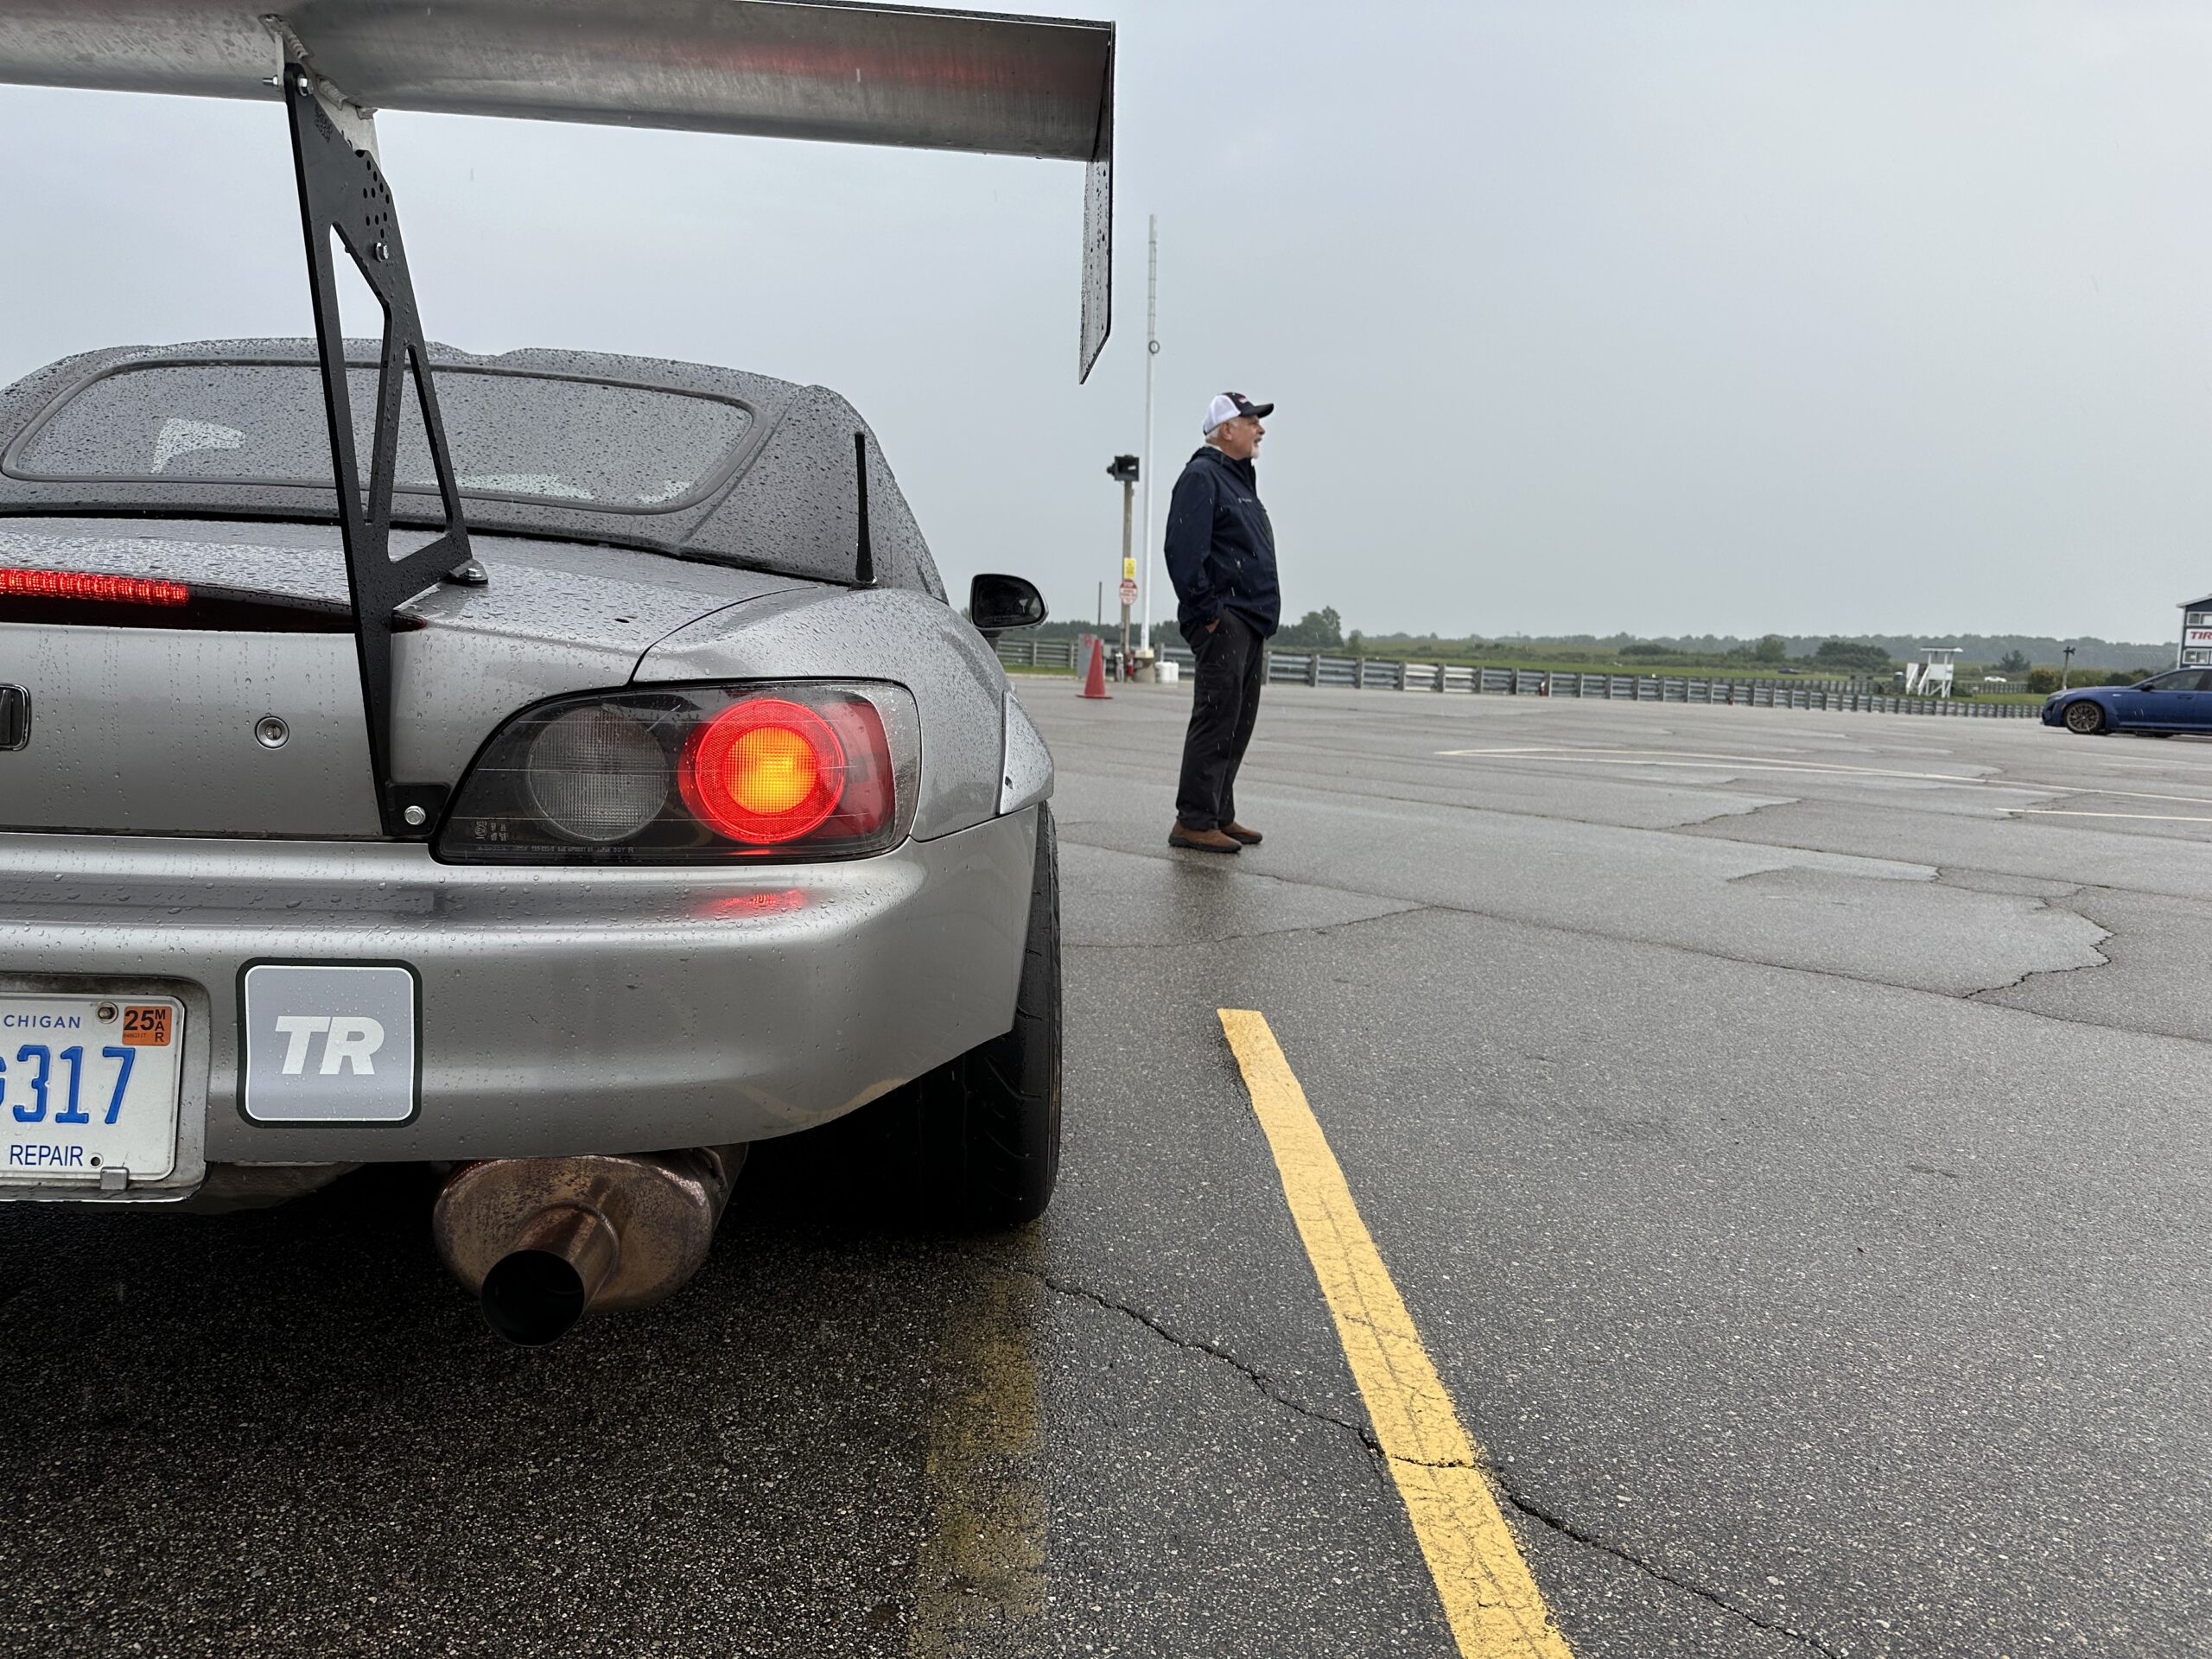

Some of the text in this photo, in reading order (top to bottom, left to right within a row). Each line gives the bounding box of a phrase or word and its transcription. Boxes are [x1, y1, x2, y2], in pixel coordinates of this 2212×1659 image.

[3, 1014, 80, 1028] CHIGAN
[124, 1010, 155, 1030] 25
[155, 1009, 166, 1042] MAR
[275, 1016, 385, 1075] TR
[0, 1045, 136, 1124] 317
[10, 1145, 83, 1166] REPAIR
